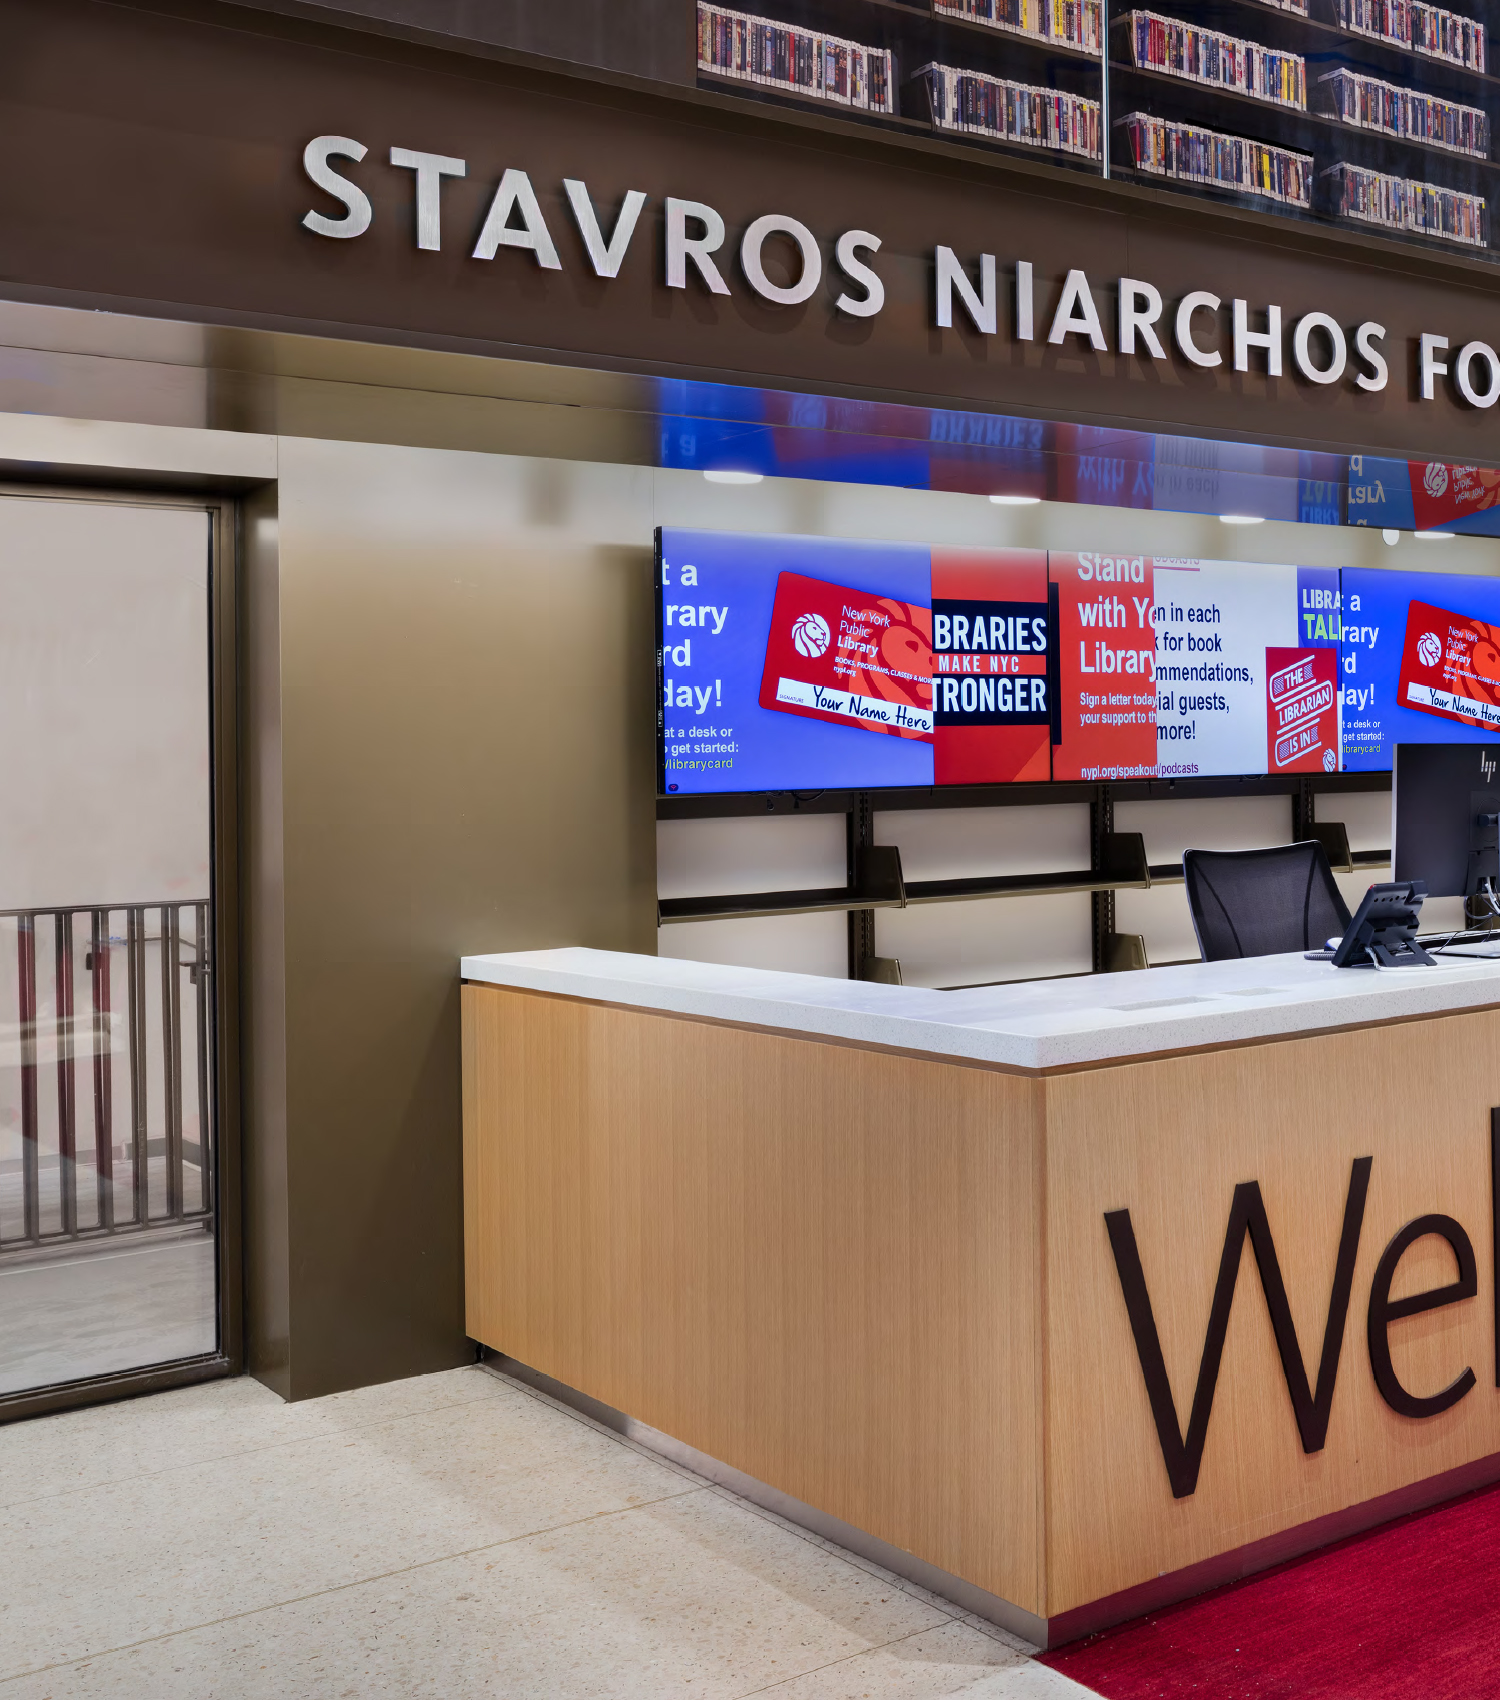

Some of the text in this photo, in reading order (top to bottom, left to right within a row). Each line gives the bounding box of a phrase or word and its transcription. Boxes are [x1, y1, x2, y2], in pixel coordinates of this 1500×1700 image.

[301, 135, 886, 317] STAVROS
[934, 244, 1389, 392] NIARCHOS
[680, 564, 698, 586] a
[1077, 552, 1145, 583] Stand
[1077, 595, 1126, 628] with
[1170, 602, 1184, 621] in
[1187, 604, 1220, 623] each
[1350, 594, 1361, 612] a
[666, 604, 729, 634] rary
[842, 605, 891, 628] New York
[840, 620, 870, 638] Public
[934, 614, 1047, 652] BRARIES
[1342, 626, 1380, 649] rary
[1448, 626, 1479, 643] New York
[837, 635, 879, 658] Library
[1163, 632, 1184, 651] for
[1187, 632, 1222, 652] book
[1446, 638, 1467, 652] Public
[834, 656, 857, 668] BOOKS,
[857, 662, 890, 676] PROGRAMS,
[890, 670, 913, 680] CLASSES
[938, 655, 1020, 672] MAKE NYC
[1080, 641, 1156, 682] Library
[1446, 648, 1472, 667] Library
[834, 666, 857, 678] nypl.org
[1155, 662, 1254, 685] mmendations,
[1283, 667, 1304, 690] THE
[932, 678, 1047, 712] TRONGER
[1080, 692, 1157, 708] Sign a letter today
[1178, 692, 1230, 716] guests,
[1278, 687, 1330, 726] LIBRARIAN
[1429, 688, 1450, 709] Your
[1452, 696, 1478, 717] Name
[814, 685, 931, 731] Your Name Here
[1080, 714, 1100, 727] your
[1102, 711, 1136, 726] support
[1138, 712, 1147, 724] to
[678, 730, 685, 738] a
[688, 726, 717, 738] desk
[720, 728, 733, 737] or
[1156, 720, 1196, 740] more!
[1354, 720, 1372, 728] desk
[671, 743, 691, 756] get
[694, 742, 739, 753] started:
[1289, 730, 1310, 754] IS IN
[1342, 732, 1385, 743] get started:
[1480, 750, 1497, 783] hp
